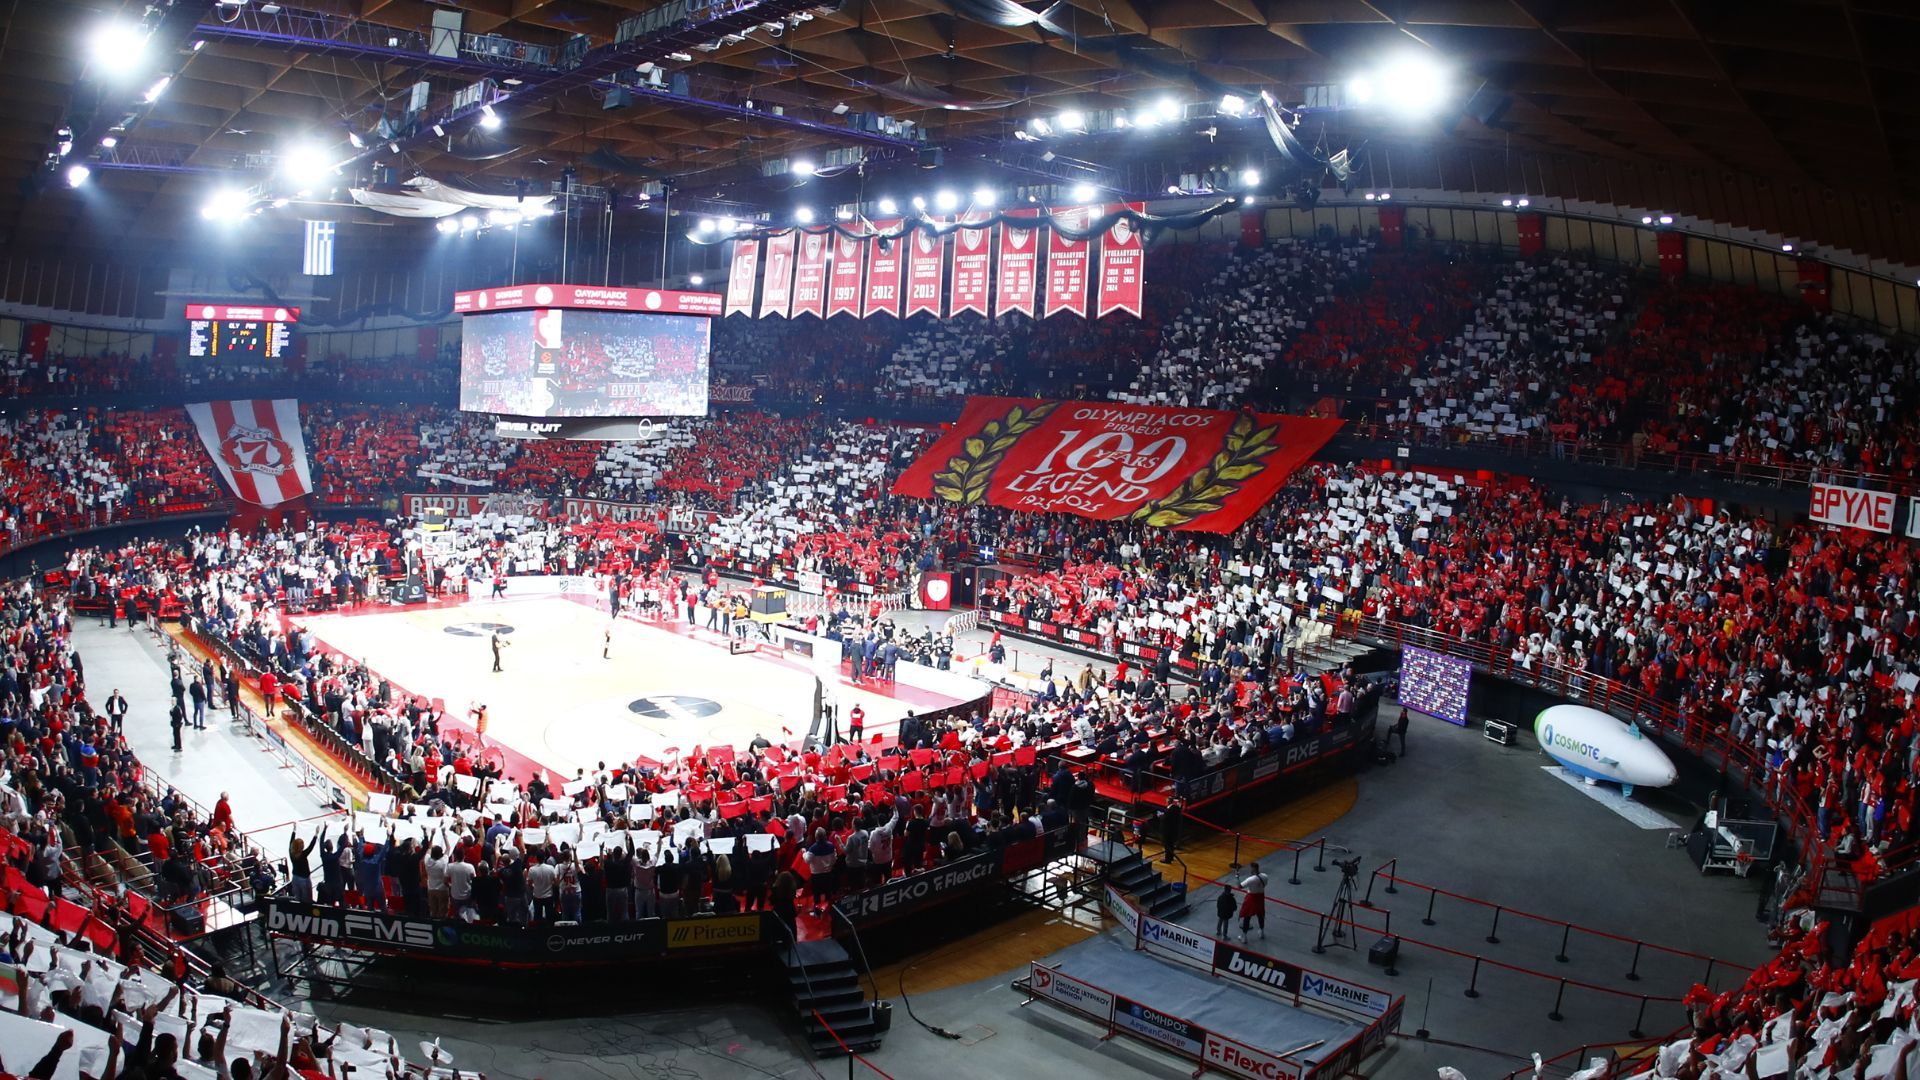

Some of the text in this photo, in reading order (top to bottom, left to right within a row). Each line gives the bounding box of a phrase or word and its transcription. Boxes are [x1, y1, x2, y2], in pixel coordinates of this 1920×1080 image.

[736, 254, 753, 280] 15
[774, 254, 785, 279] 7
[799, 287, 818, 301] 2013
[834, 286, 855, 300] 1997
[871, 285, 894, 299] 2012
[913, 284, 935, 298] 2013
[530, 422, 562, 434] QUIT
[1074, 408, 1214, 427] OLYMPIACOS
[1104, 422, 1163, 436] PIRAEUS
[1025, 430, 1187, 484] 100
[1093, 449, 1160, 469] YEARS
[1004, 472, 1149, 502] LEGEND
[1286, 741, 1320, 765] AXE
[1554, 734, 1600, 761] COSMOTE
[945, 863, 995, 889] FlexCar
[883, 882, 929, 908] EKO
[268, 904, 340, 938] bwin
[1112, 899, 1137, 929] COSMOTE
[565, 933, 645, 947] NEVER QUIT
[694, 925, 756, 943] Piraeus
[1160, 928, 1200, 950] MARINE
[1228, 952, 1286, 987] bwin
[1324, 982, 1370, 1003] MARINE
[1143, 1010, 1188, 1035] ΟΜΗΡΟΣ
[1223, 1045, 1296, 1080] FlexCar
